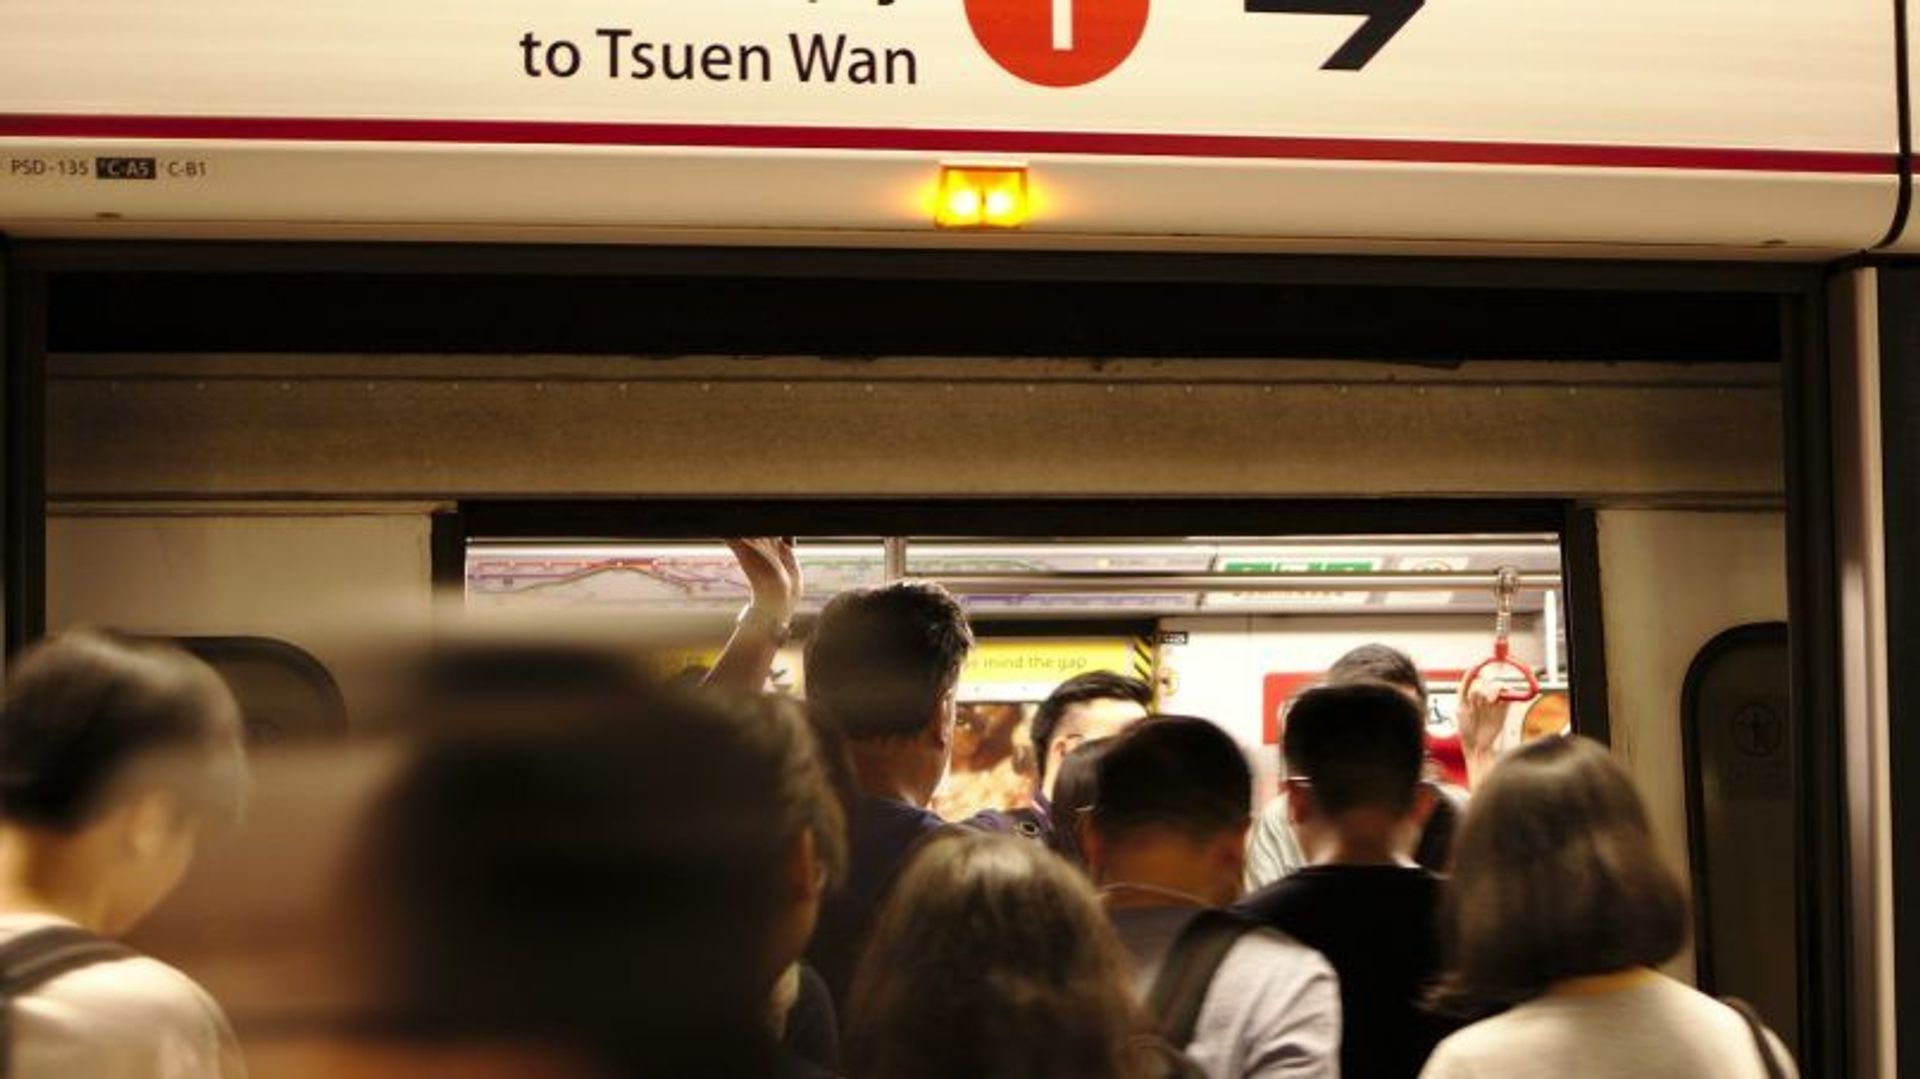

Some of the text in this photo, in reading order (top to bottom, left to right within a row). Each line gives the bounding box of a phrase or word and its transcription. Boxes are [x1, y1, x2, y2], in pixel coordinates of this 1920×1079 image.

[519, 28, 916, 84] to Tsuen Wan
[983, 655, 1024, 669] mind
[1029, 655, 1052, 669] the
[1058, 657, 1087, 672] gap
